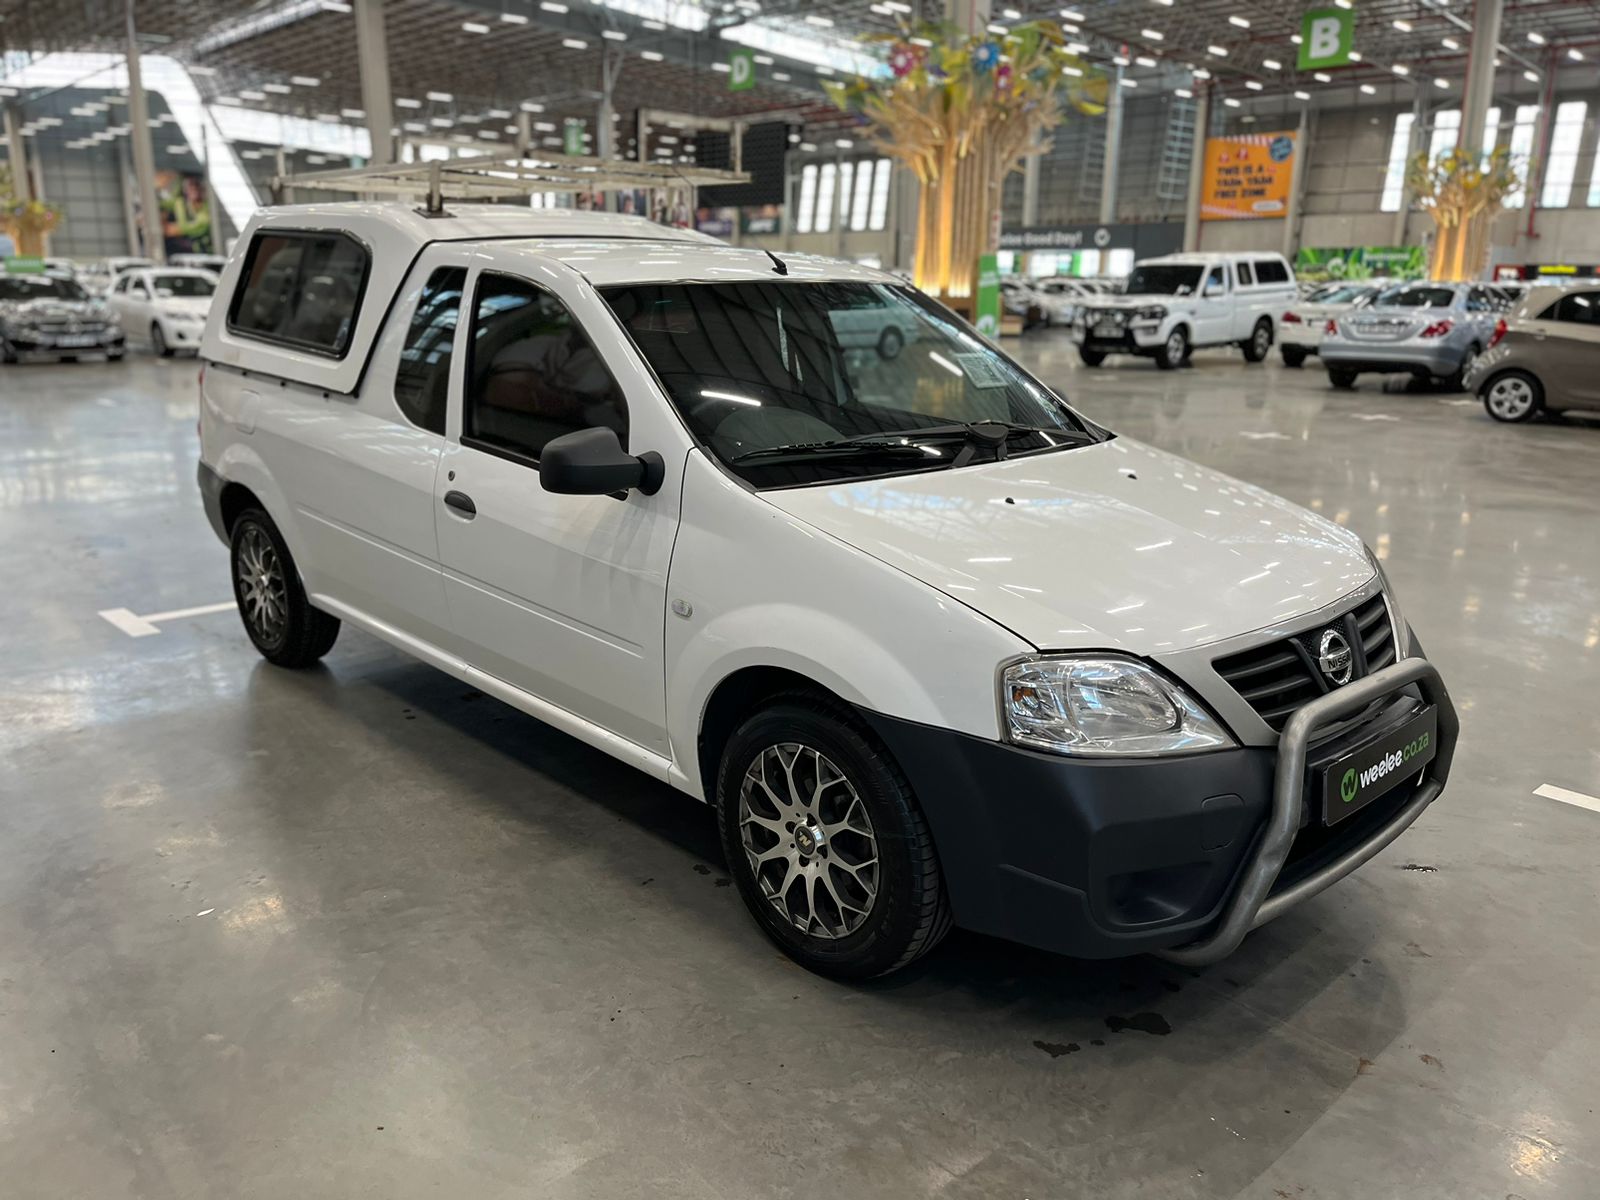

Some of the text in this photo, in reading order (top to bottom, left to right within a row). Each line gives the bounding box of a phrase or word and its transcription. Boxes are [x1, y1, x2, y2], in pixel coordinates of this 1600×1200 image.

[1309, 16, 1341, 59] B
[732, 55, 750, 84] D
[1023, 231, 1054, 247] Good
[1328, 651, 1350, 670] NISS
[1360, 732, 1429, 789] weelee.co.za
